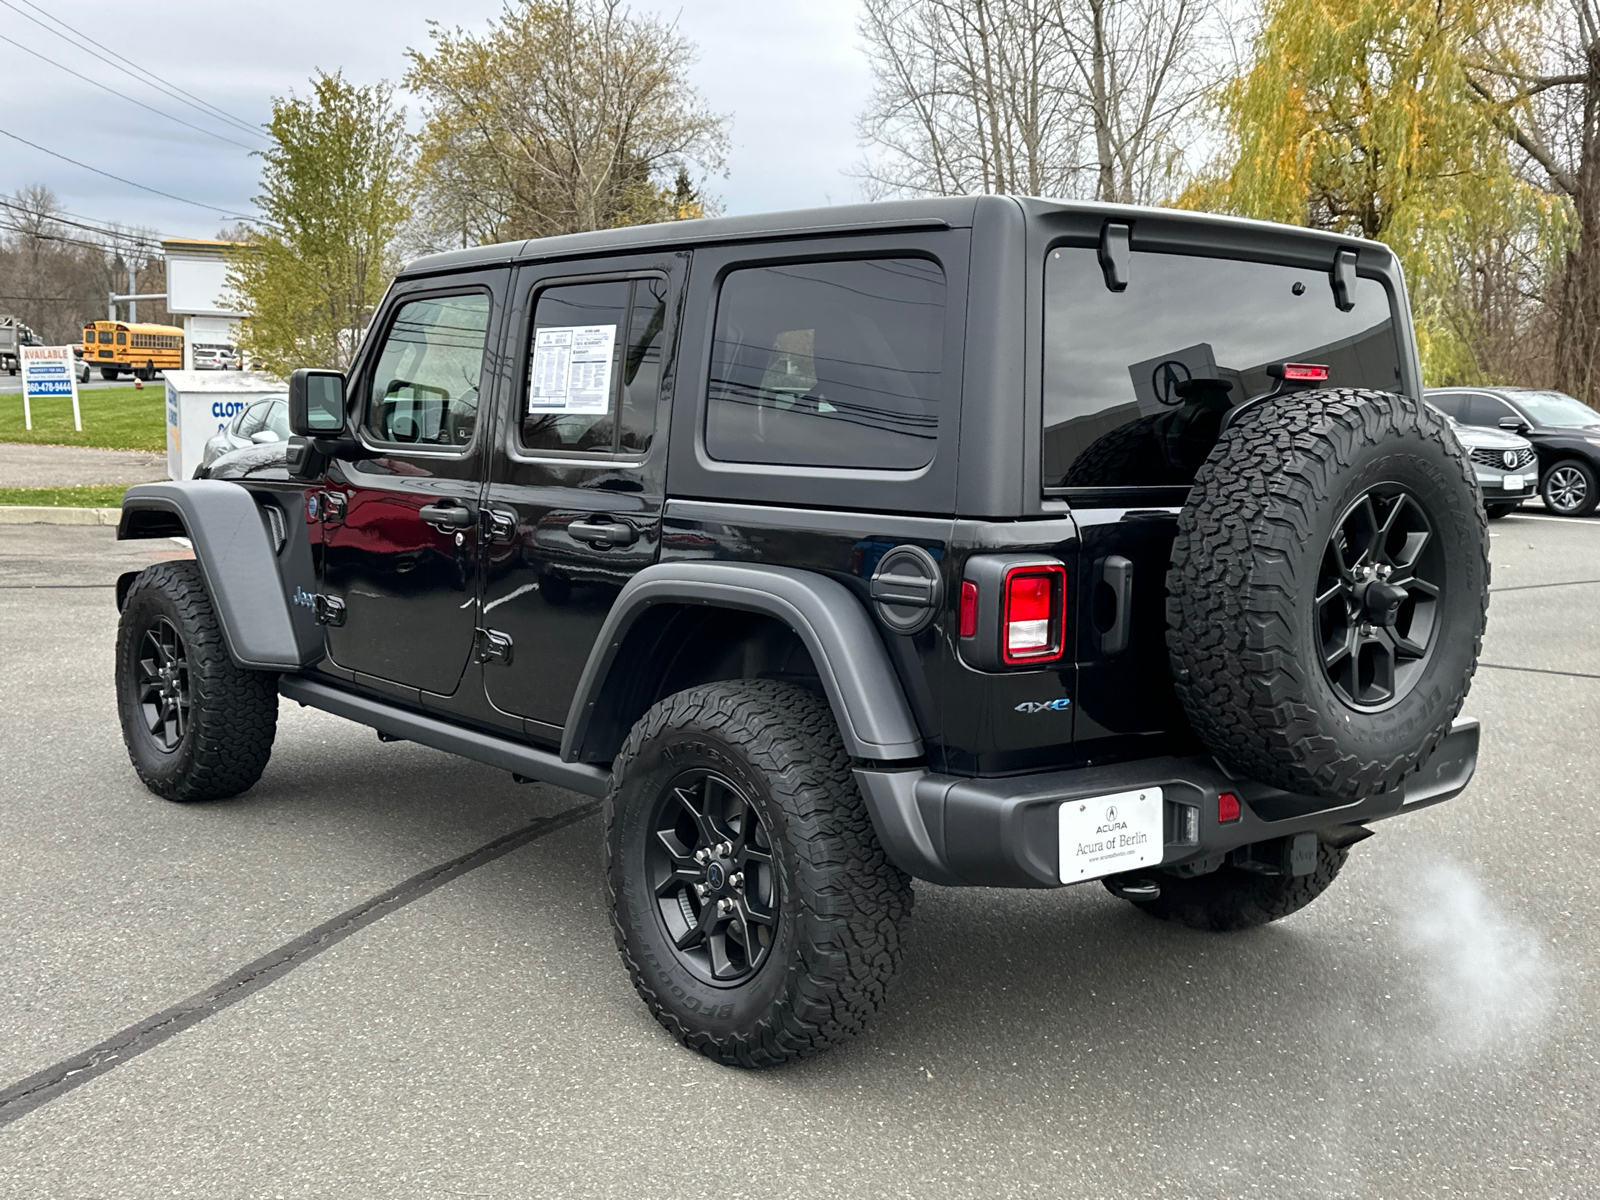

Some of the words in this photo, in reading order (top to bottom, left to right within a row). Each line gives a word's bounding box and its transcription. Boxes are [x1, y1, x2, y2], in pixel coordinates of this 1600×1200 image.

[24, 349, 68, 359] AVAILABLE
[293, 585, 317, 614] Jeep
[1095, 821, 1128, 835] ACURA
[1076, 841, 1104, 856] Acura
[1105, 837, 1117, 850] of
[1119, 831, 1148, 848] Berlin
